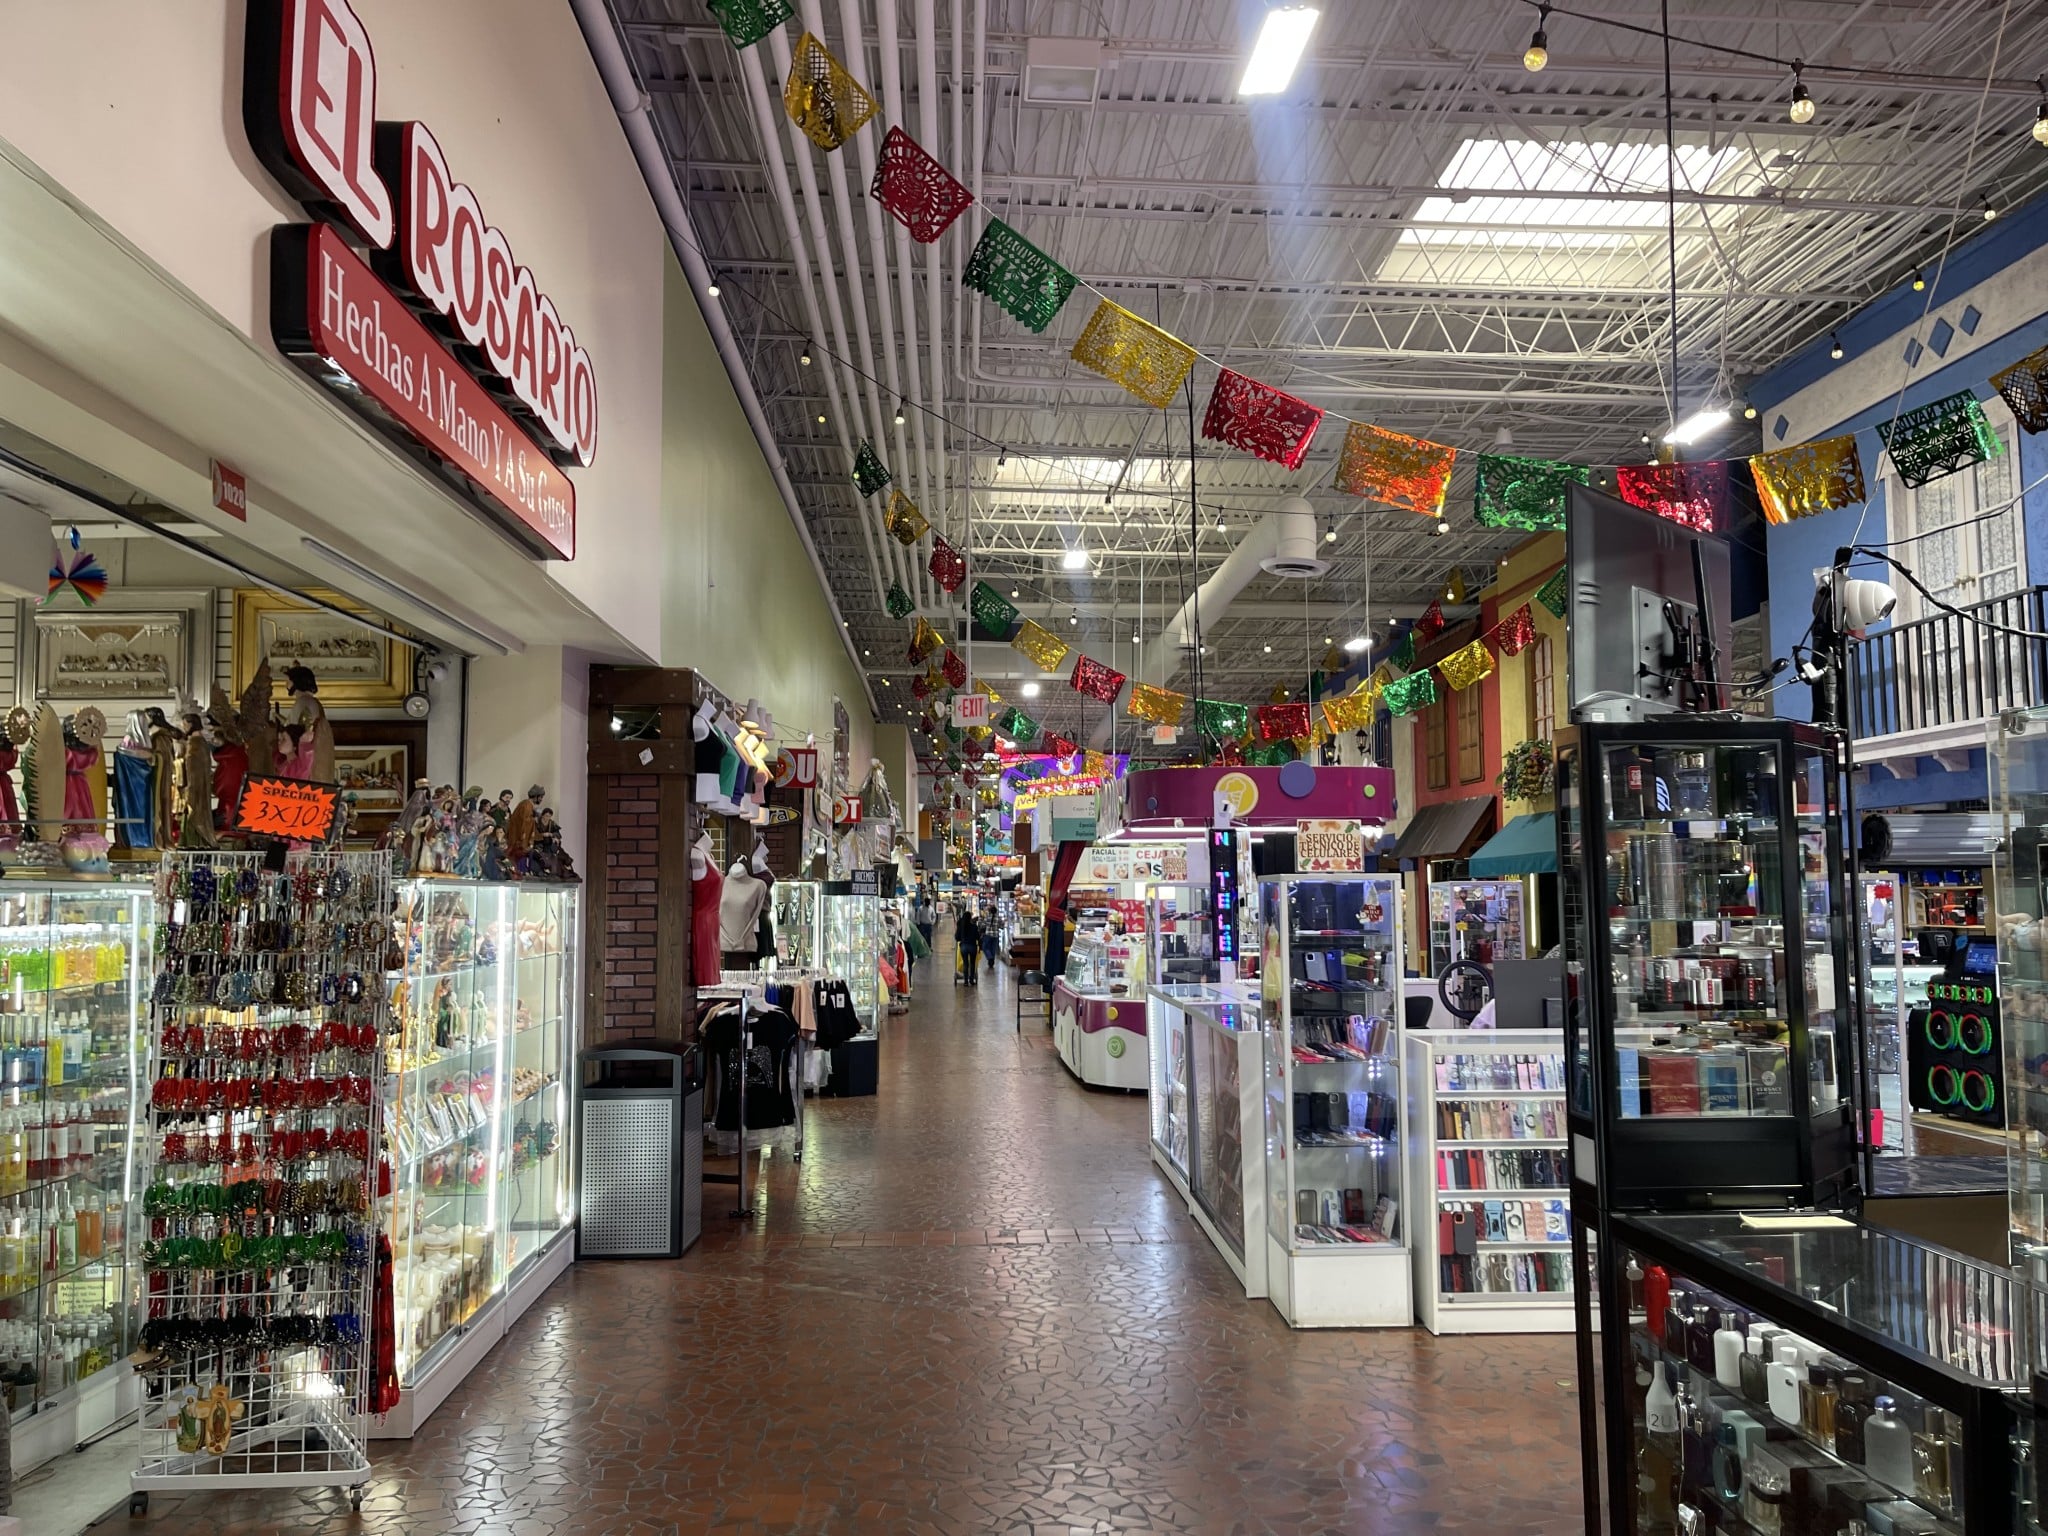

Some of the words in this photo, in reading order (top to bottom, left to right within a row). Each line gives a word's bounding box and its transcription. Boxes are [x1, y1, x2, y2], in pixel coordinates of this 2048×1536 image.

[300, 0, 381, 222] EL
[415, 145, 593, 452] ROSARIO
[321, 249, 413, 402] Hechas
[417, 353, 435, 422] A
[438, 367, 489, 470] Mano
[491, 420, 504, 482] Y
[504, 437, 516, 494] A
[518, 449, 536, 513] Su
[222, 481, 245, 509] 1028
[962, 698, 984, 718] EXIT
[796, 753, 816, 784] U
[262, 786, 320, 802] SPECIAL
[847, 799, 860, 820] T
[1305, 833, 1354, 843] SERVICIO
[1346, 841, 1360, 851] DE
[1091, 848, 1116, 856] FACIAL
[1300, 848, 1360, 858] CELULARES
